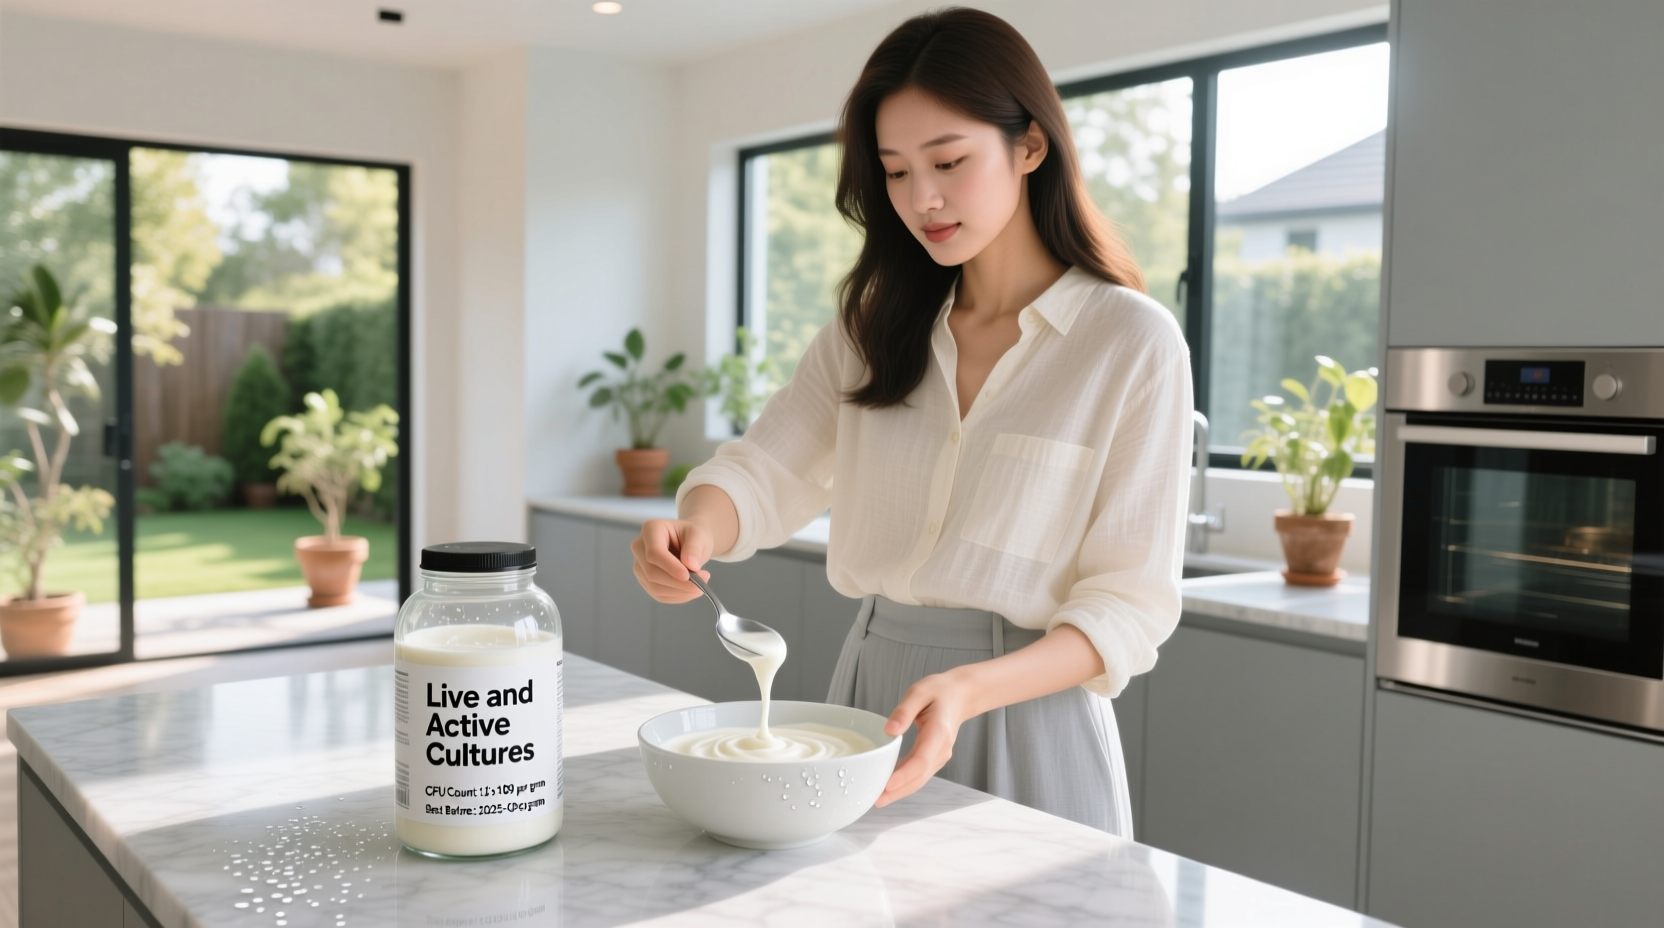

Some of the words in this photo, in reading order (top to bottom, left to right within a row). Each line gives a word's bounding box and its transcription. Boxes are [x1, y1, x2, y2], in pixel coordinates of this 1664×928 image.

[426, 682, 480, 709] Live
[486, 679, 533, 708] and
[425, 712, 511, 738] Active
[426, 742, 535, 767] Cultures
[425, 785, 446, 797] CFU
